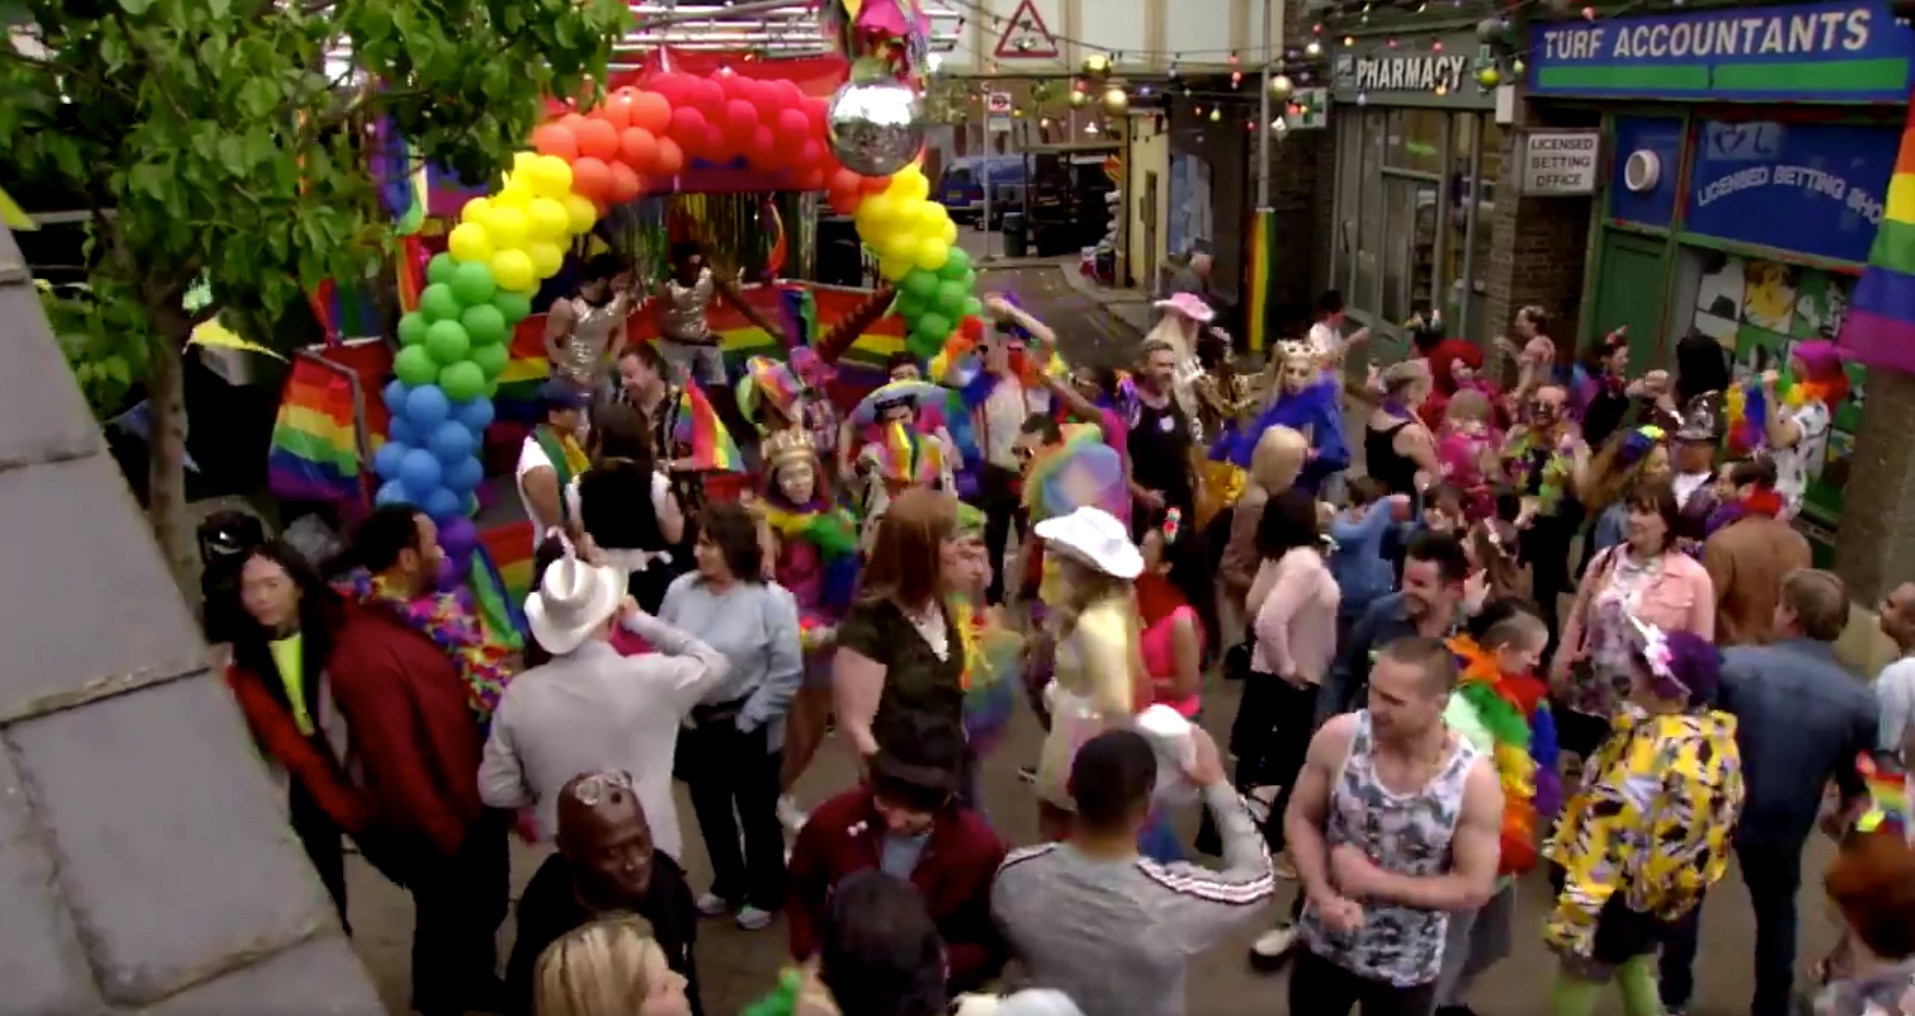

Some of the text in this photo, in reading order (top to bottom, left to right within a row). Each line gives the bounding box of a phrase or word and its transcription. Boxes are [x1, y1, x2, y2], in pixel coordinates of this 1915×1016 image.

[1544, 10, 1870, 59] TURF ACCOUNTANTS
[1356, 55, 1465, 89] PHARMACY
[1531, 138, 1594, 150] LICENSED
[1532, 156, 1591, 169] BETTING
[1536, 173, 1582, 187] OFFICE
[1698, 165, 1882, 224] LICENSED BETTING SHO
